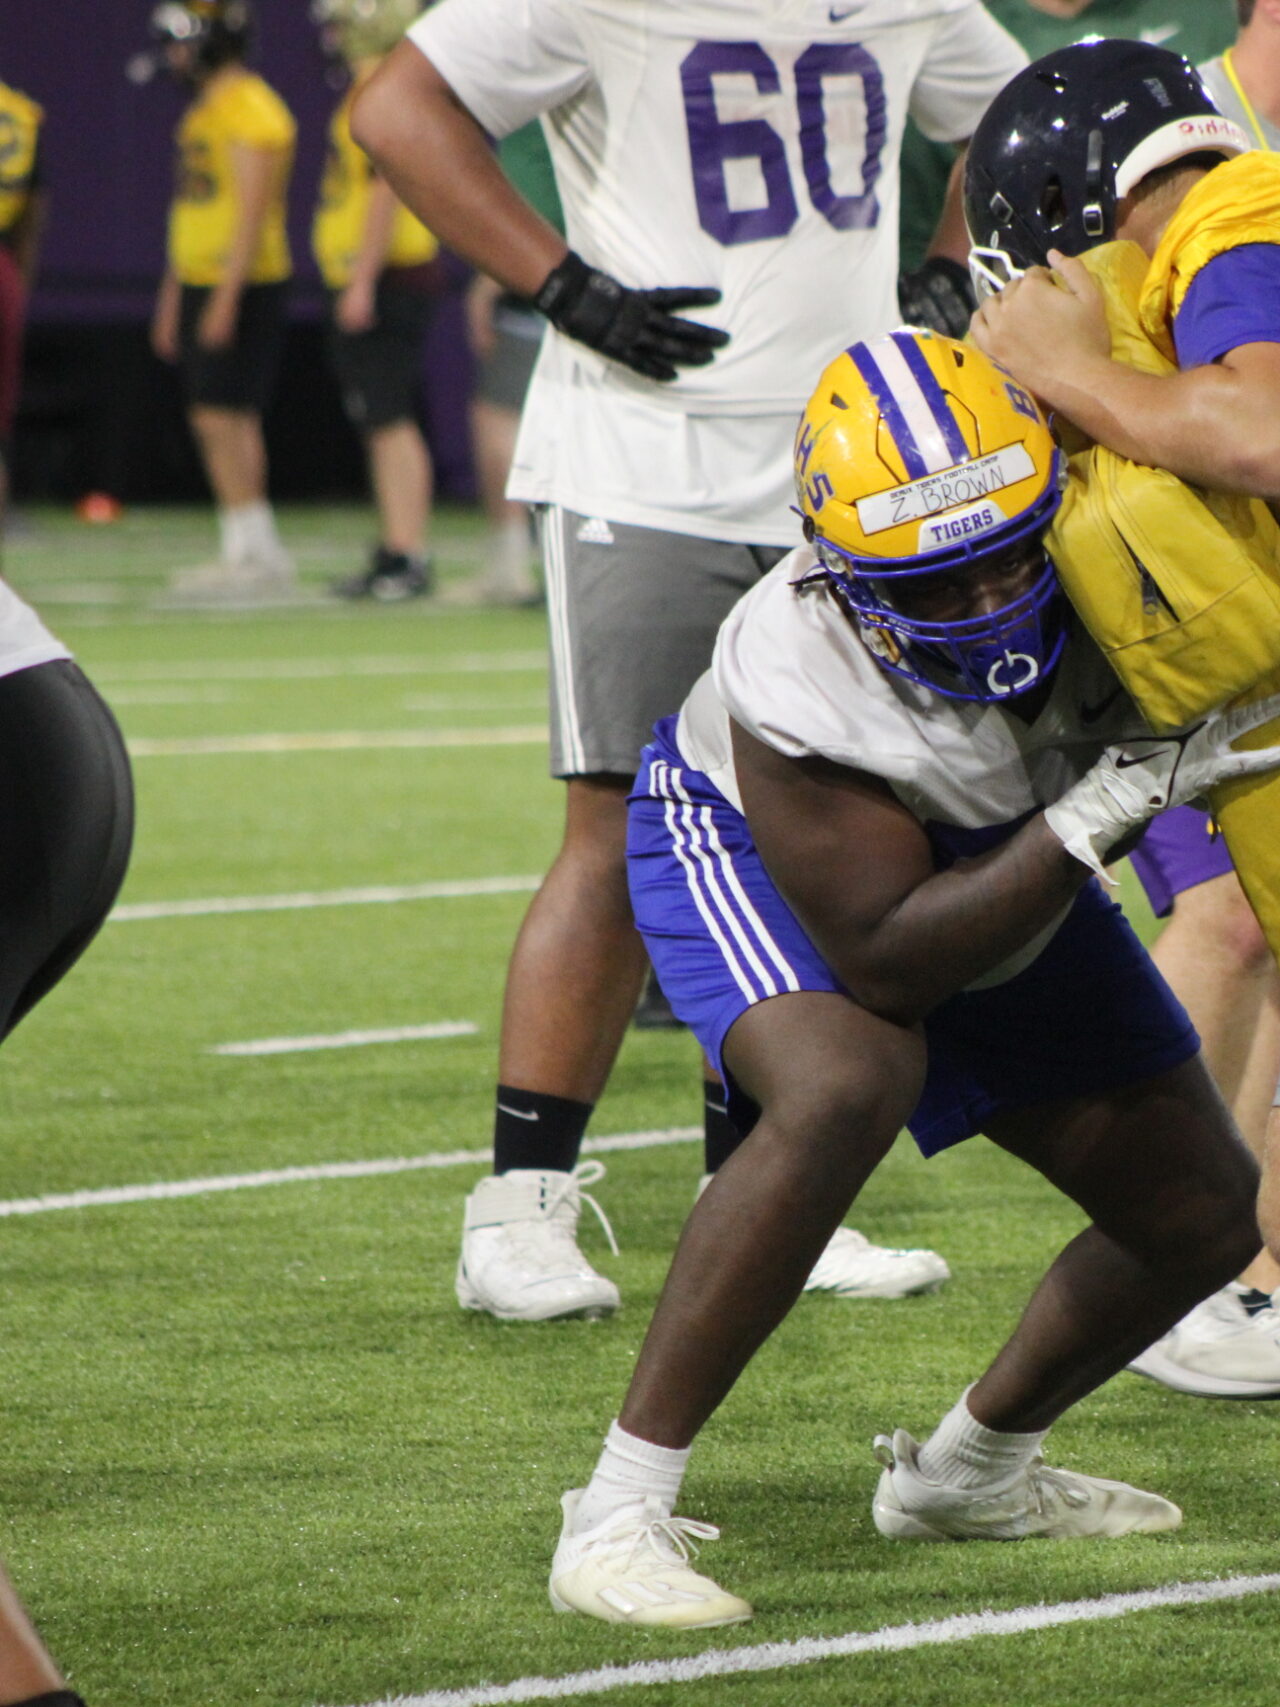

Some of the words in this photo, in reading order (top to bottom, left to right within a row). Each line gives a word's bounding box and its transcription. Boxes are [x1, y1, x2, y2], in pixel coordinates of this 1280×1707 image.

[679, 40, 887, 248] 60
[889, 497, 918, 524] Z.
[920, 465, 1006, 513] BROWN
[930, 508, 994, 543] TIGERS
